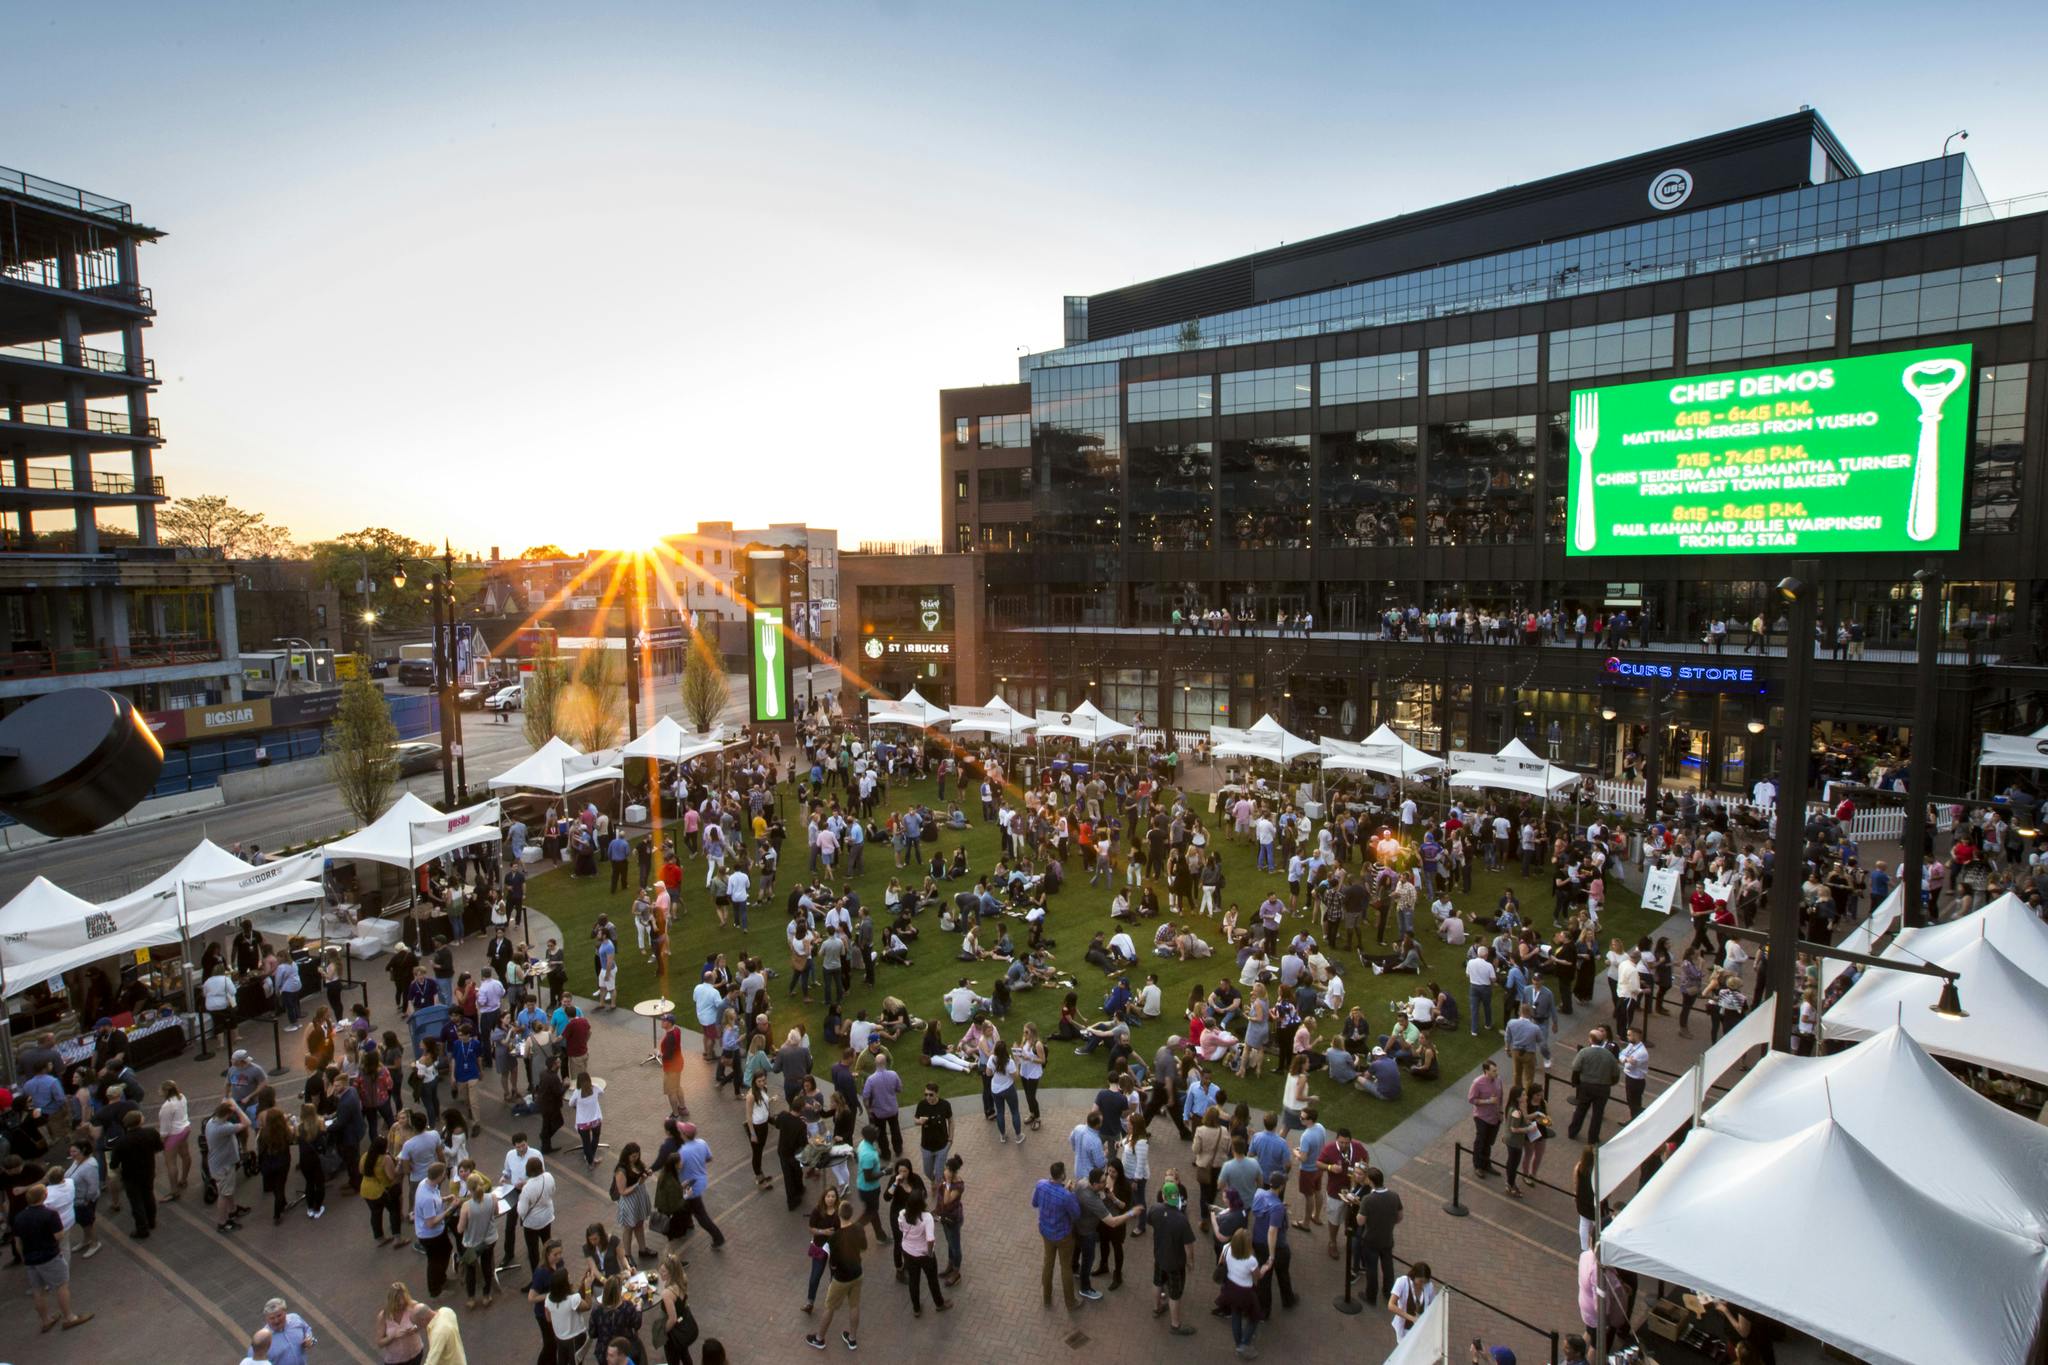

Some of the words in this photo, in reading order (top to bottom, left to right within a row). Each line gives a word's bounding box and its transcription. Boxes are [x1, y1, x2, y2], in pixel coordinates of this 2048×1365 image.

[1669, 379, 1735, 404] CHEF
[1739, 368, 1835, 397] DEMOS
[1675, 410, 1711, 427] 6:15
[1728, 404, 1771, 422] 6:45
[1775, 399, 1814, 417] P.M.
[1622, 427, 1694, 446] MATTHIAS
[1697, 422, 1760, 439] MERGES
[1763, 418, 1813, 434] FROM
[1816, 411, 1879, 429] YUSHO
[1676, 452, 1711, 468] 7:15
[1725, 448, 1766, 466] 7:45
[1769, 445, 1809, 461] P.M.
[1595, 472, 1638, 486] CHRIS
[1639, 467, 1704, 483] TEIXEIRA
[1706, 465, 1740, 479] AND
[1742, 459, 1835, 477] SAMANTHA
[1838, 454, 1912, 471] TURNER
[1640, 482, 1683, 496] FROM
[1685, 480, 1728, 493] WEST
[1731, 475, 1780, 491] TOWN
[1783, 473, 1850, 489] BAKERY
[1672, 505, 1709, 521] 8:15
[1722, 503, 1765, 520] 8:45
[1769, 502, 1808, 517] P.M.
[1612, 523, 1648, 536] PAUL
[1650, 522, 1701, 535] KAHAN
[1704, 521, 1738, 534] AND
[1740, 519, 1785, 533] JULIE
[1787, 516, 1882, 531] WARPINSKI
[1679, 534, 1724, 548] FROM
[1726, 533, 1754, 547] BIG
[1756, 532, 1797, 546] STAR
[1619, 663, 1672, 678] CUBS
[1679, 667, 1753, 681] STORE
[256, 869, 277, 884] DORR
